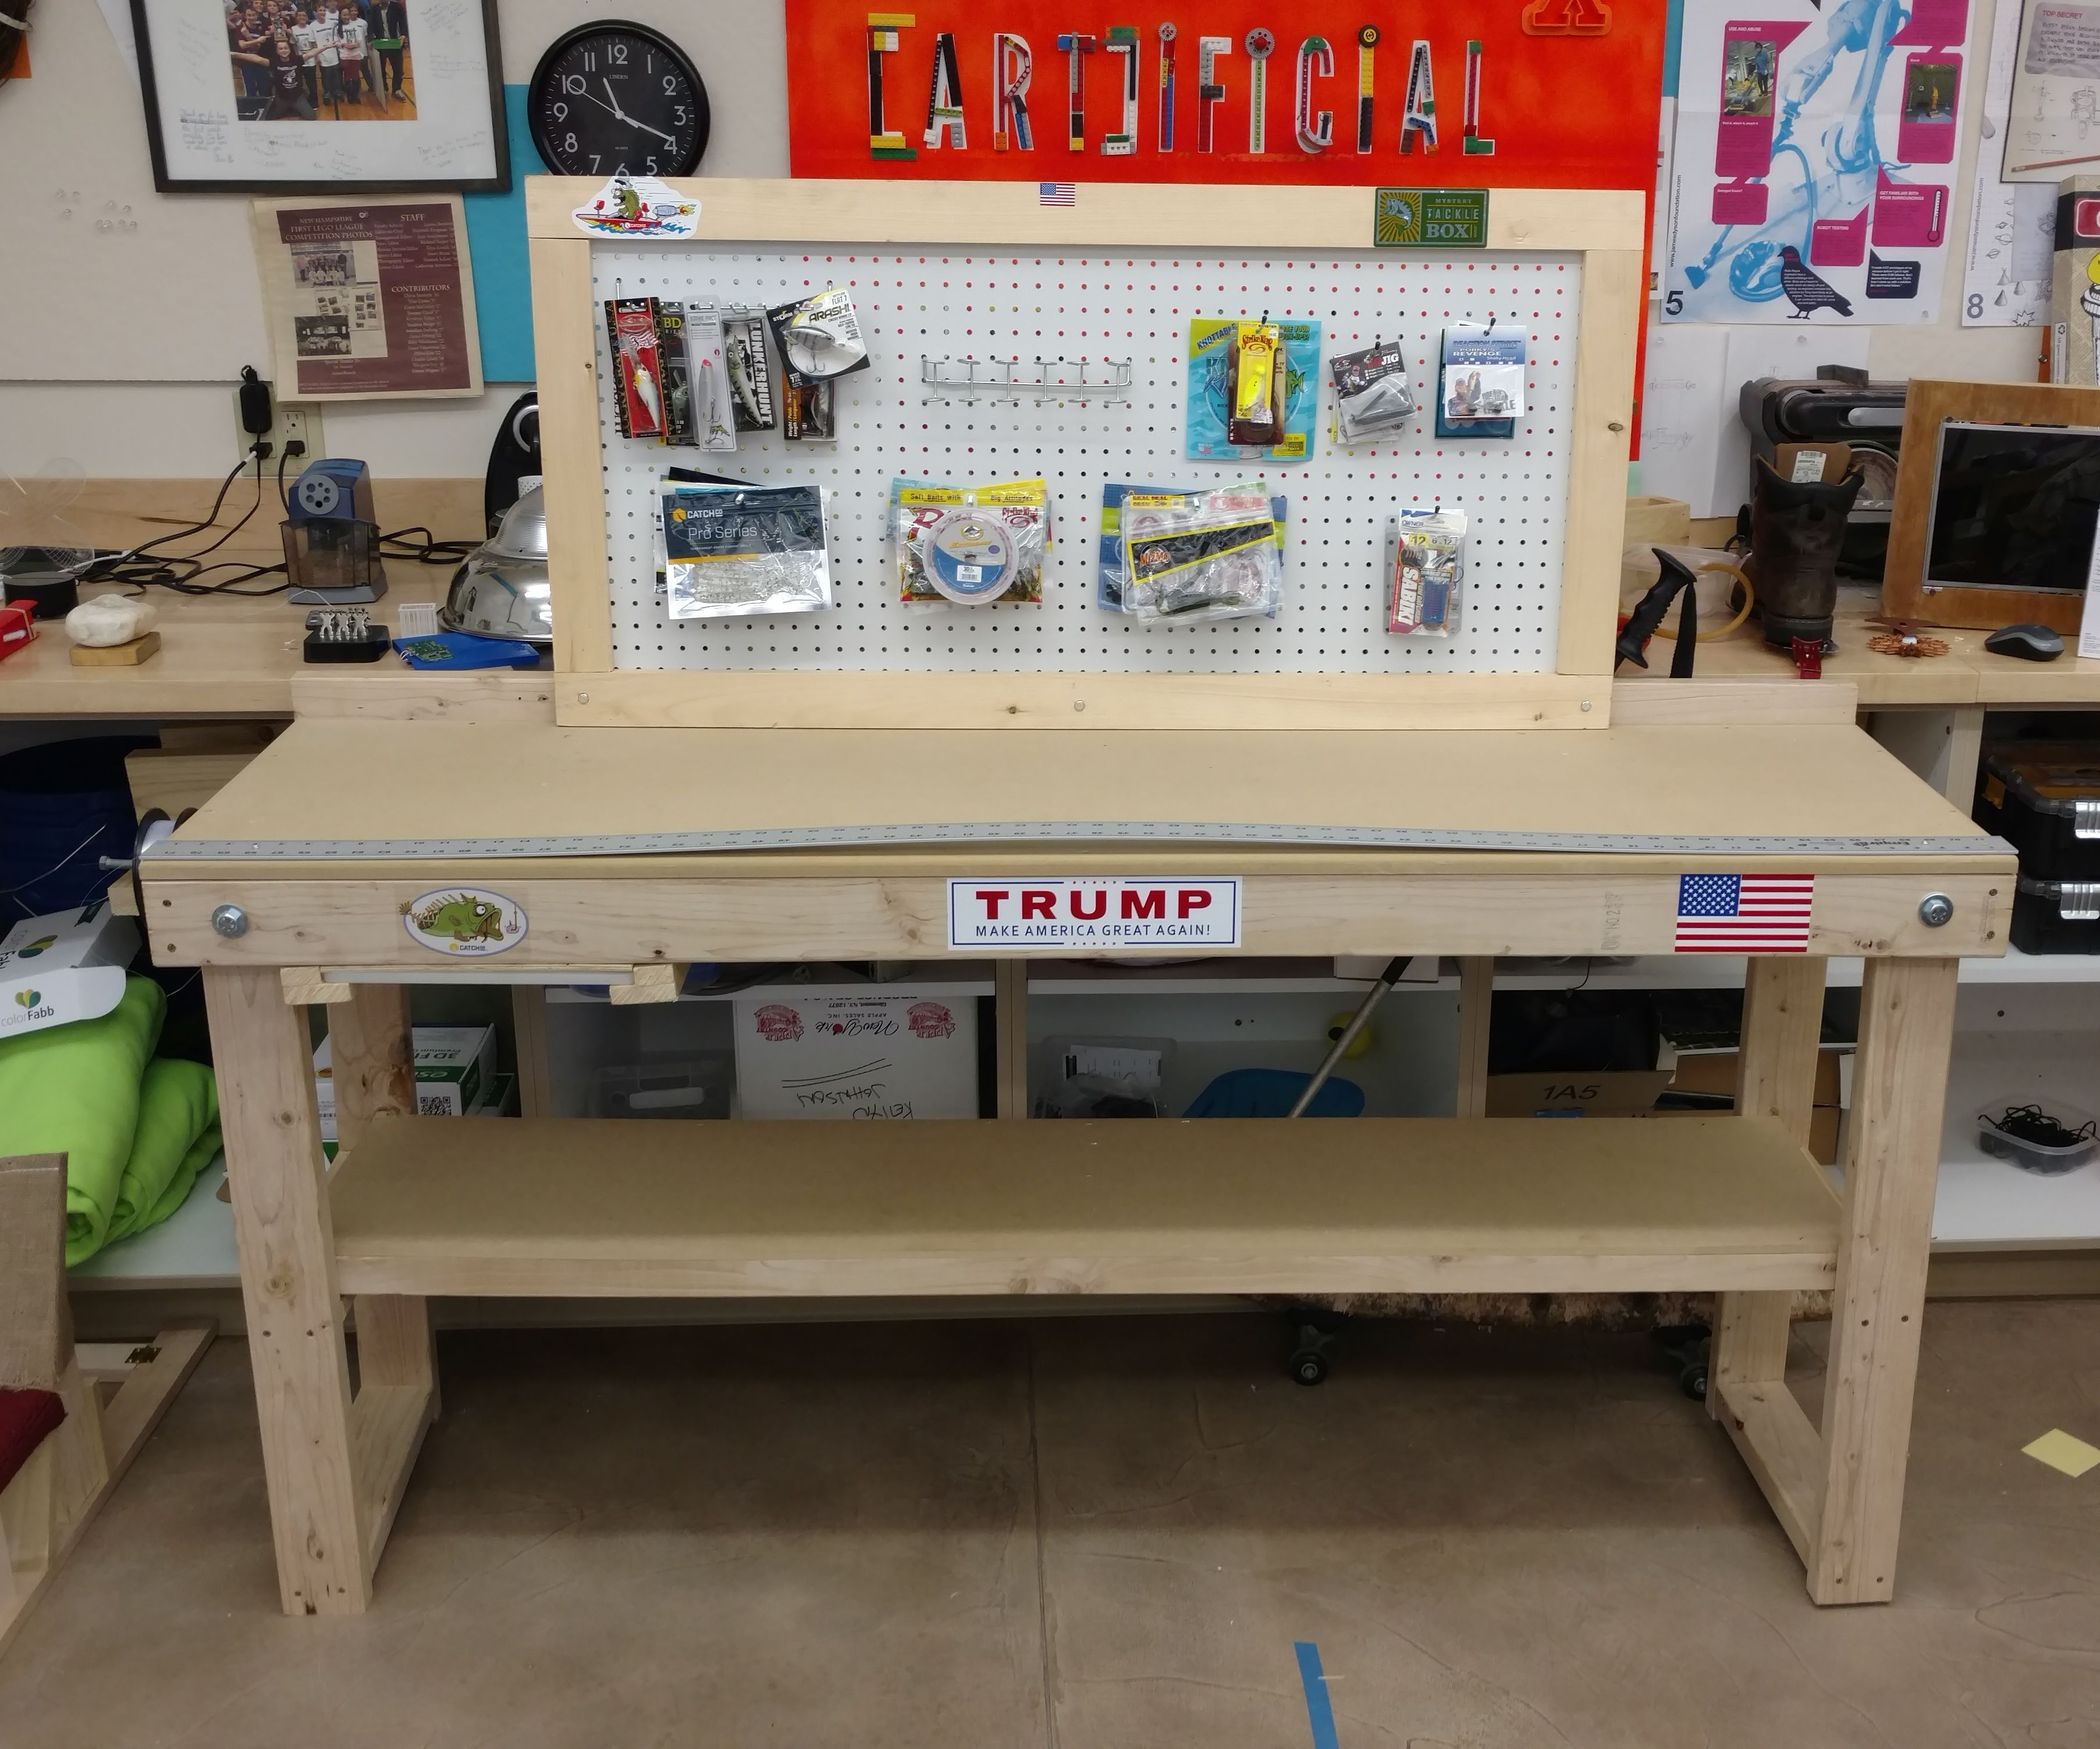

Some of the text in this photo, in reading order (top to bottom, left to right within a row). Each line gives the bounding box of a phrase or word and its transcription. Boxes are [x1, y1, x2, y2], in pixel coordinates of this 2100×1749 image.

[584, 51, 596, 72] 11
[607, 44, 629, 65] 12
[562, 74, 587, 95] 10
[662, 75, 677, 96] 2
[553, 102, 569, 122] 9
[673, 105, 687, 126] 3
[564, 132, 579, 153] 8
[663, 135, 678, 155] 4
[589, 154, 602, 174] 7
[646, 156, 658, 176] 5
[400, 213, 425, 221] STAFF
[1426, 208, 1480, 220] TACKLE
[285, 231, 373, 241] COMPETITION PHOTOS
[290, 223, 363, 233] FIRST LEGO LEAGUE
[1426, 223, 1469, 238] BOX
[391, 284, 450, 293] CONTRIBUTORS
[808, 303, 851, 322] ARASHI
[1665, 290, 1684, 316] 5
[1966, 293, 1984, 319] 8
[772, 311, 793, 322] STORM
[1381, 352, 1400, 366] JIG
[687, 509, 715, 519] CATCH
[688, 526, 758, 541] Pro Series
[1398, 566, 1419, 626] SABIKI
[975, 889, 1212, 920] TRUMP
[976, 923, 1211, 937] MAKE AMERICA GREAT AGAIN!
[0, 1005, 55, 1028] colorFabb
[1543, 1084, 1601, 1101] 1A5
